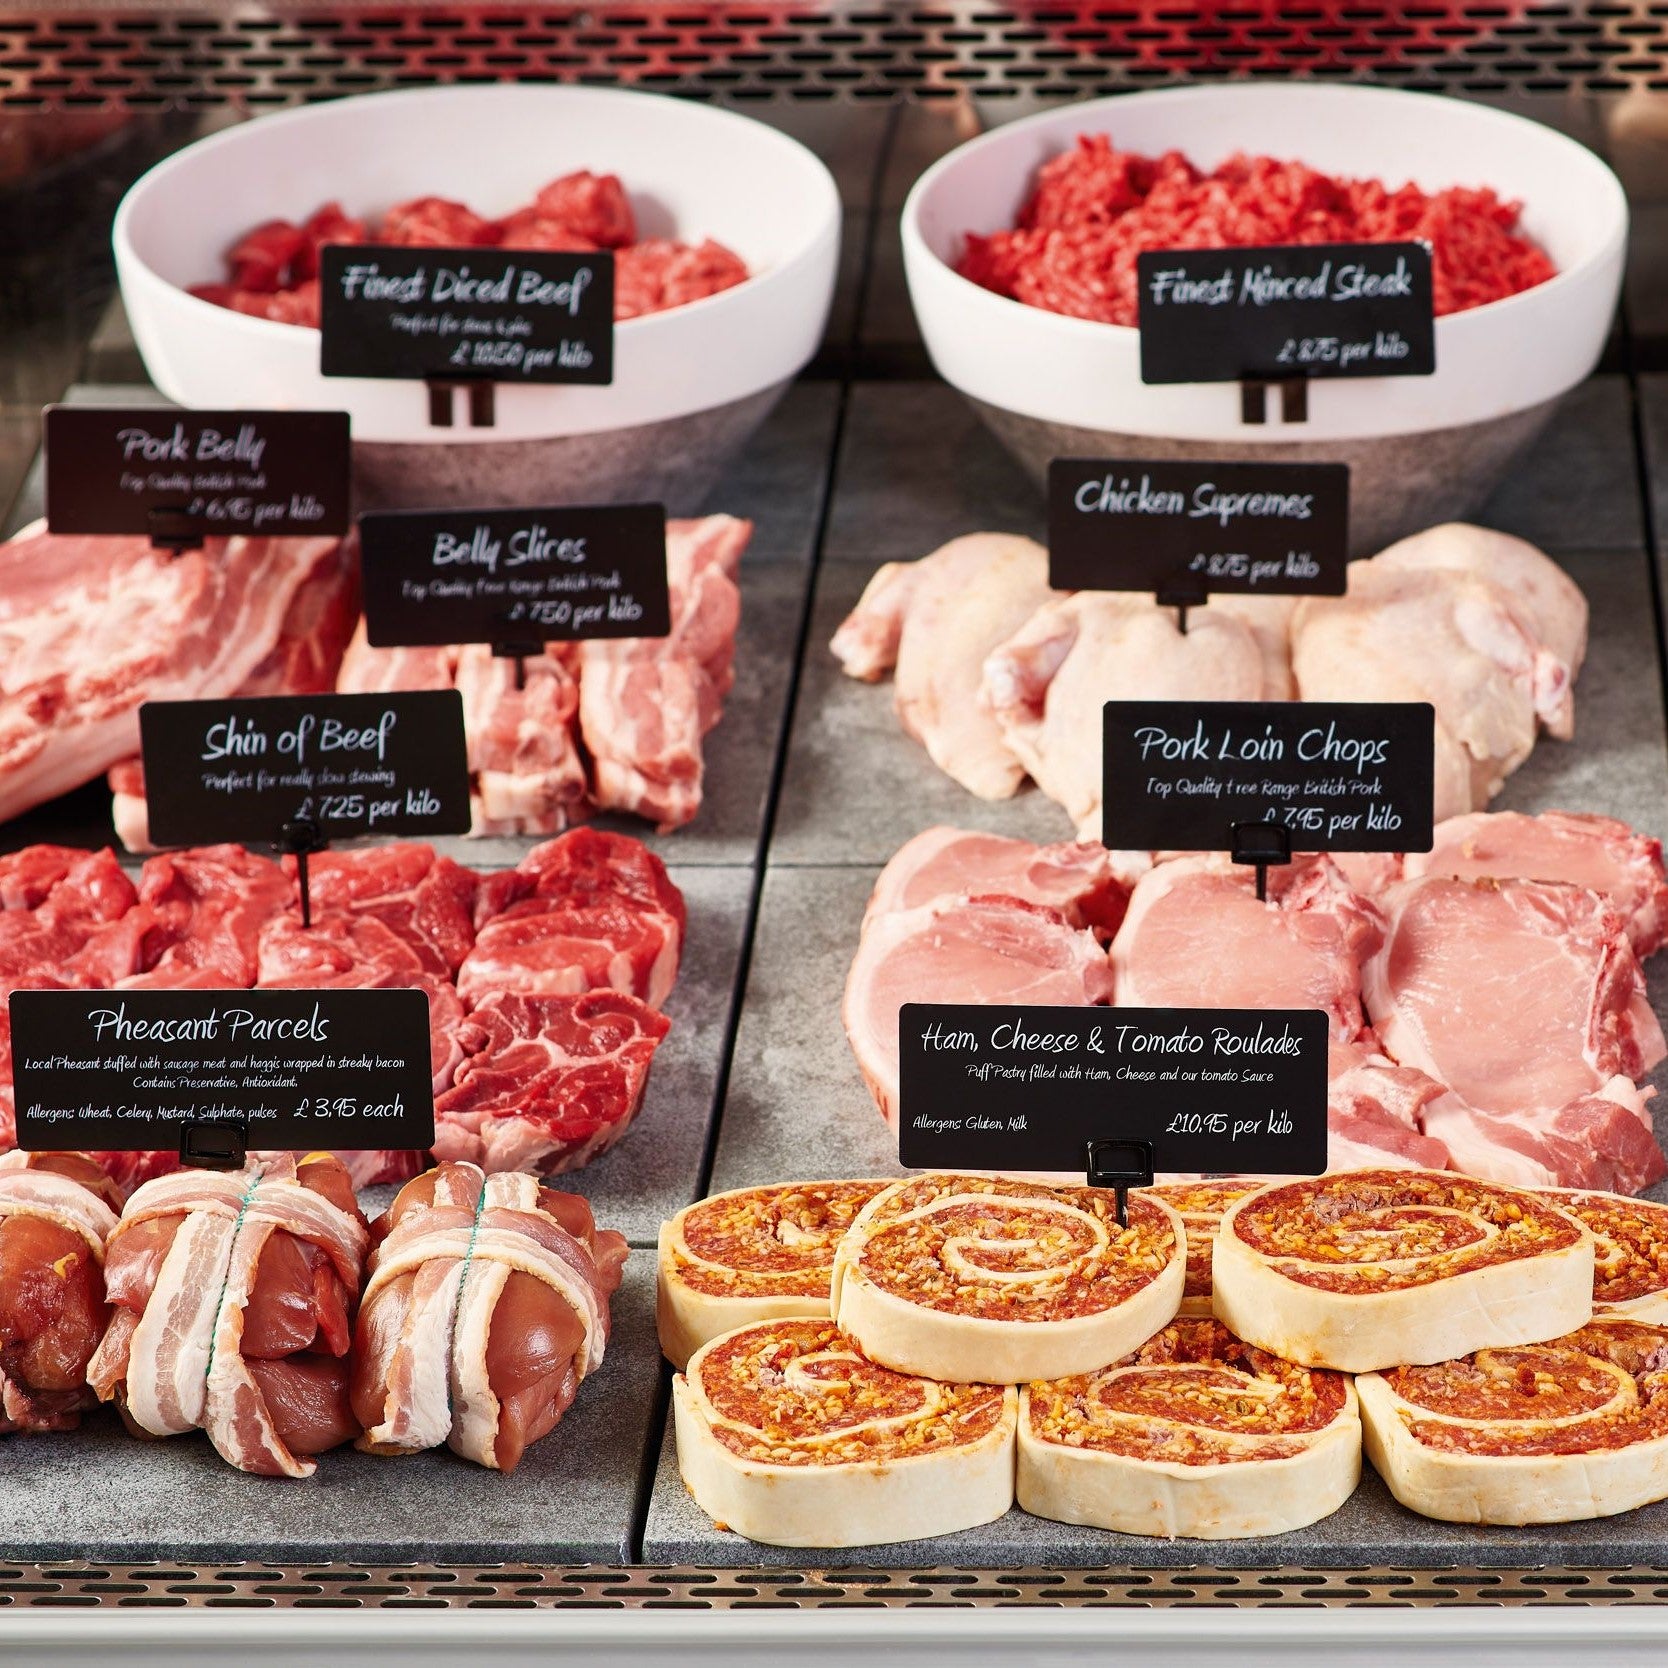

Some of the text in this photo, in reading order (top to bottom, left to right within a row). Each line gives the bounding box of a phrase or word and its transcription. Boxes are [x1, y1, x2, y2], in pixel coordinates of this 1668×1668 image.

[340, 263, 593, 317] Finest Diced Beef
[1149, 256, 1412, 306] Finest Minced Steak
[522, 348, 556, 375] per
[557, 339, 594, 369] kilo
[1339, 342, 1373, 368] per
[1374, 331, 1410, 359] kilo
[116, 422, 267, 471] Pork Belly
[253, 502, 287, 528] per
[289, 493, 325, 521] kilo
[1074, 474, 1315, 528] Chicken Supremes
[433, 524, 587, 574] Belly Slices
[1249, 561, 1283, 586] per
[1284, 550, 1320, 578] kilo
[572, 604, 605, 631] per
[607, 593, 643, 621] kilo
[201, 710, 396, 763] Shin of Beef
[1134, 719, 1390, 775] Pork Loin Chops
[201, 765, 395, 795] Perfect for really slow stewing
[1147, 777, 1171, 799] Top
[1175, 776, 1222, 799] Quality
[1261, 779, 1300, 800] Range
[1304, 777, 1346, 795] British
[1348, 777, 1382, 795] Pork
[293, 796, 314, 820] £
[368, 799, 401, 826] per
[406, 788, 441, 816] kilo
[1327, 814, 1363, 839] per
[1366, 802, 1402, 831] kilo
[88, 1001, 330, 1042] Pheasant Parcels
[921, 1017, 1303, 1057] Ham, Cheese & Tomato Roulades
[25, 1054, 405, 1073] Local Pheasant stuffed with sausage meat and haggis wrapped in streaky bacon
[133, 1074, 298, 1089] Contains Preservative, Antioxidant.
[965, 1062, 1274, 1083] Puff Pastry filled with Ham, Cheese and our tomato Sauce
[26, 1103, 75, 1124] Allergens:
[78, 1103, 112, 1119] Wheat,
[116, 1104, 153, 1122] Celery,
[199, 1103, 245, 1121] Sulphate,
[248, 1103, 277, 1122] pulses
[293, 1098, 309, 1118] £
[362, 1093, 404, 1118] each
[913, 1113, 1028, 1133] Allergens: Gluten, Milk
[1165, 1108, 1293, 1142] £10.95 per kilo
